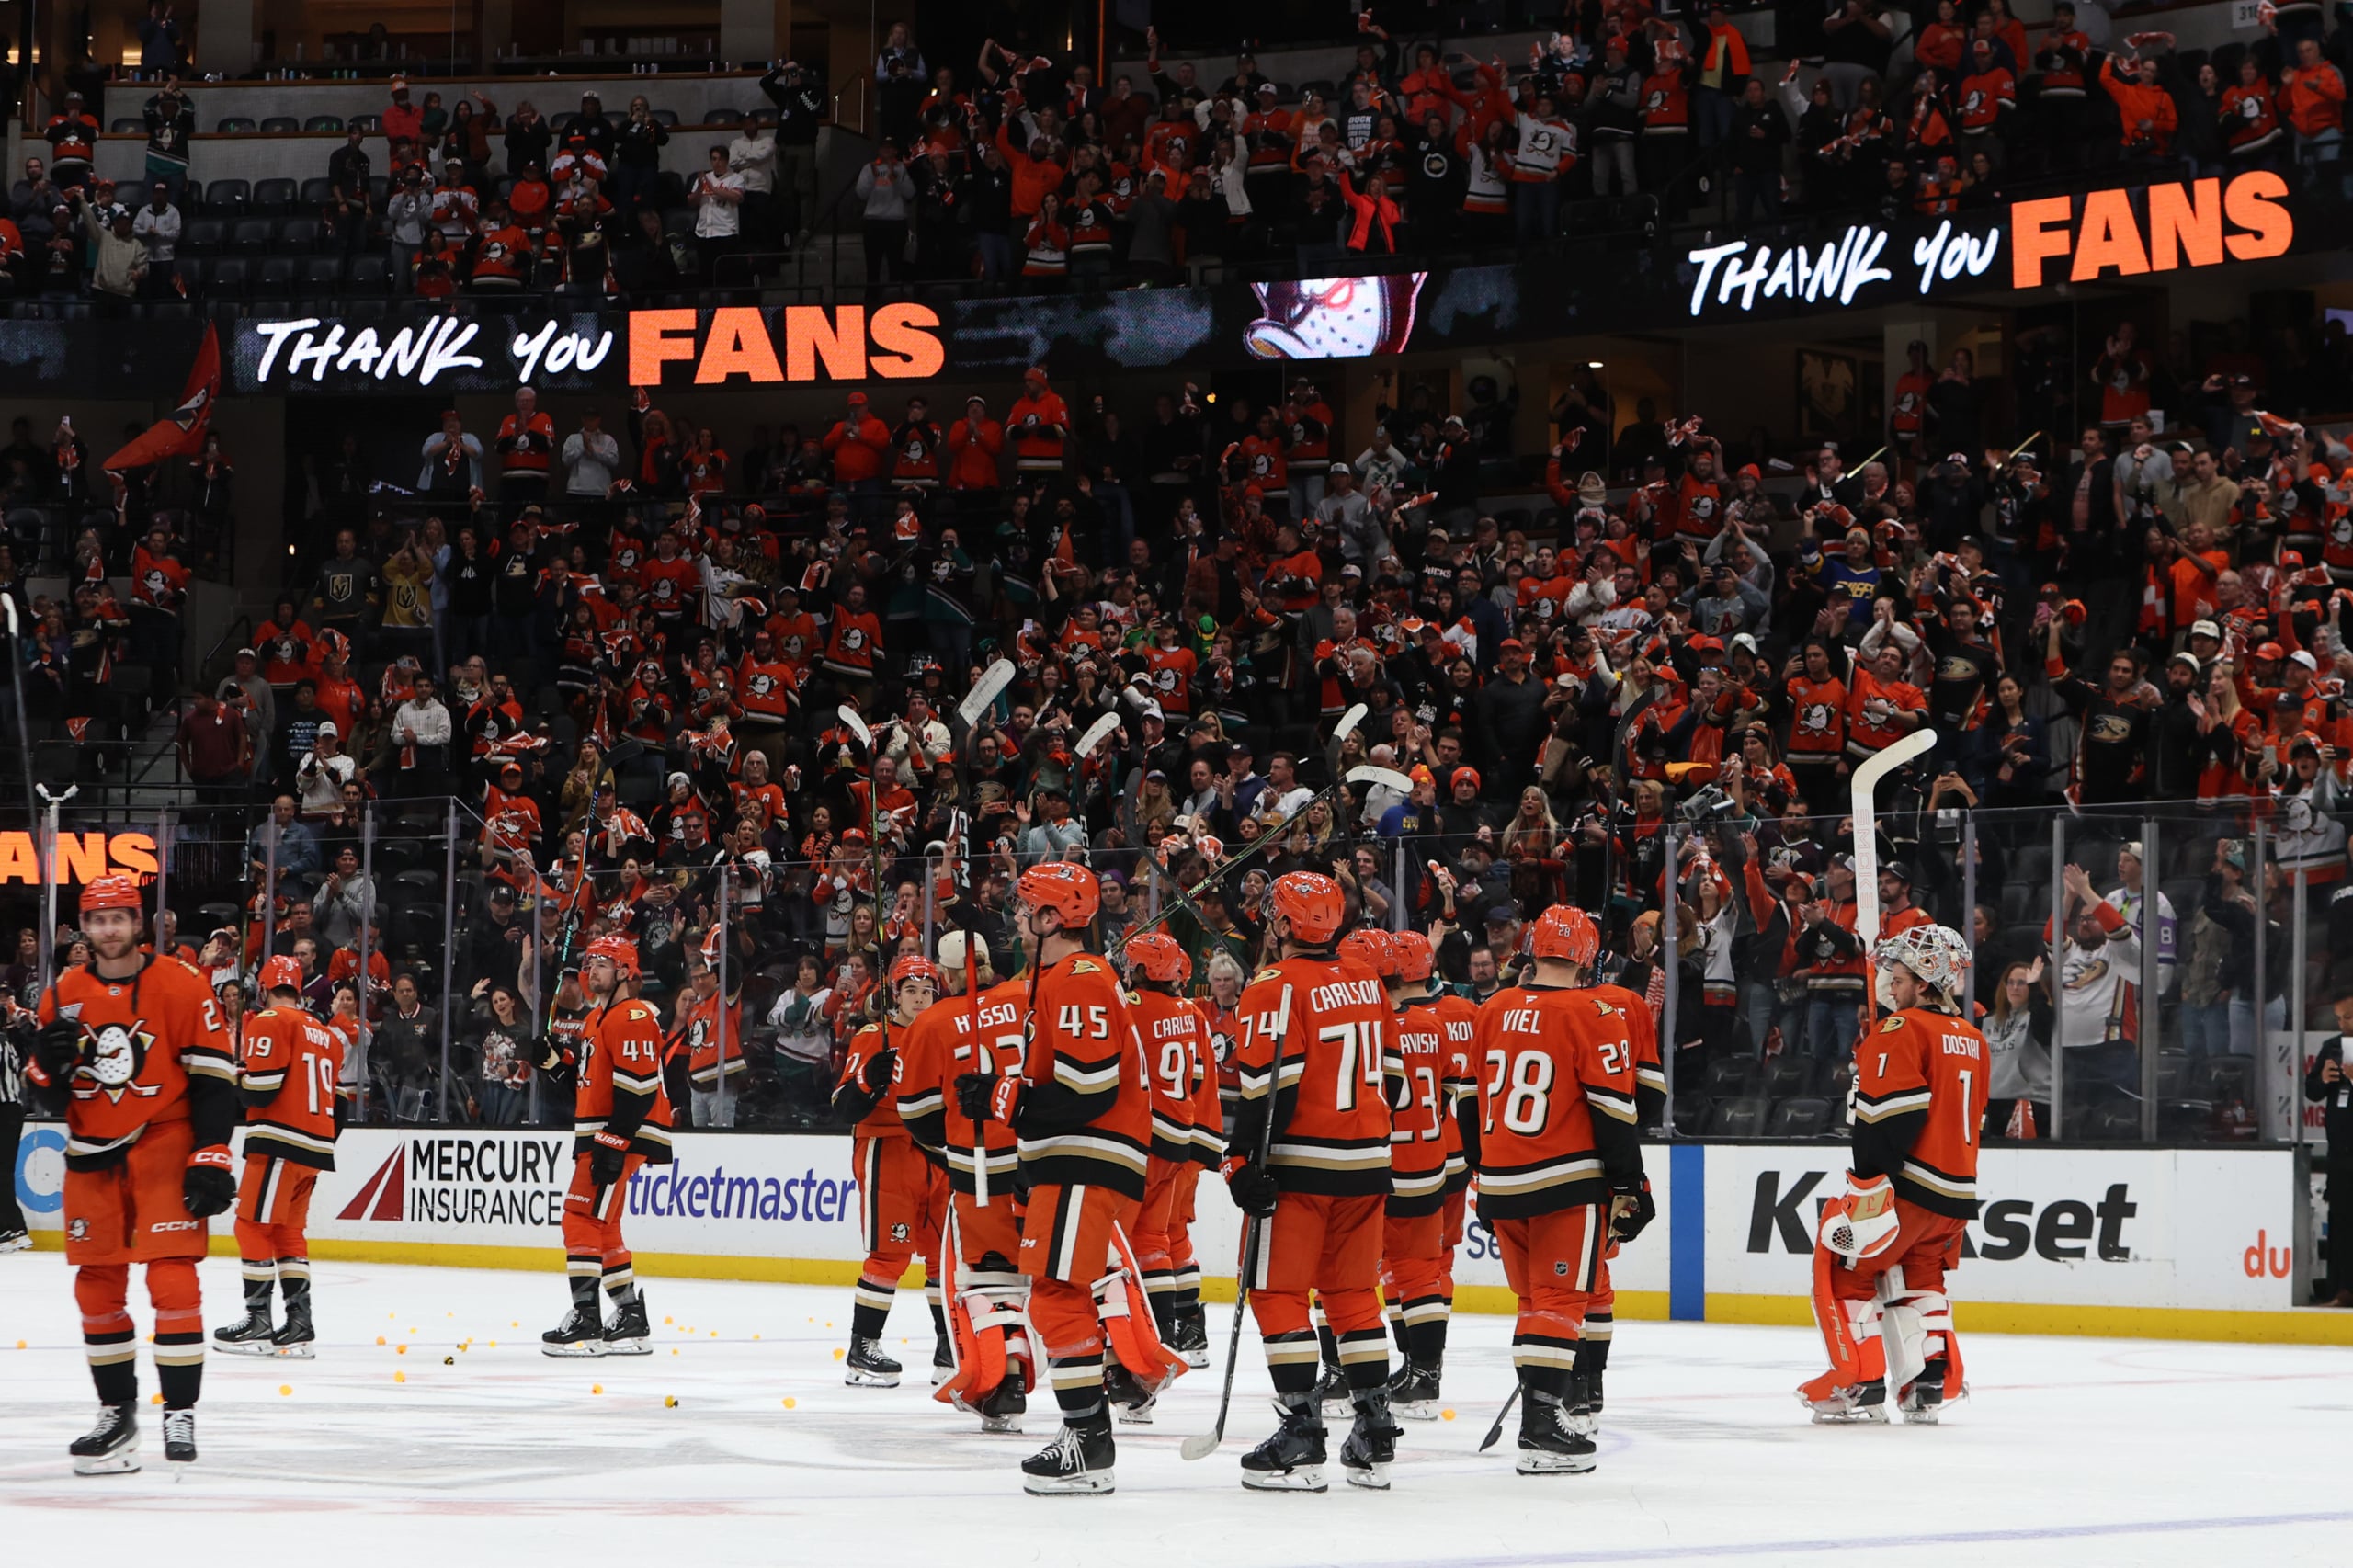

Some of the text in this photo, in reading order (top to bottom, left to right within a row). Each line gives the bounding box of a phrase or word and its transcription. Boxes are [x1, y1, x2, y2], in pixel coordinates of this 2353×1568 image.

[1688, 225, 1892, 316] THANK
[2011, 169, 2294, 290] FANS
[256, 314, 483, 386] THANK
[628, 302, 945, 386] FANS
[957, 809, 971, 888] CCM
[1079, 814, 1092, 868] CCM
[1558, 926, 1571, 937] 28
[2161, 926, 2173, 944] 8
[1058, 1005, 1109, 1040] 45
[1240, 1010, 1279, 1049] 74
[1502, 1008, 1540, 1035] VIEL
[247, 1036, 273, 1058] 19
[622, 1040, 656, 1062] 44
[1319, 1021, 1386, 1111] 74
[1598, 1040, 1631, 1074] 28
[1877, 1053, 1889, 1078] 1
[301, 1052, 334, 1118] 19
[1484, 1049, 1554, 1135] 28
[1958, 1069, 1972, 1147] 1
[412, 1139, 563, 1184] MERCURY
[411, 1188, 562, 1225] INSURANCE
[629, 1158, 856, 1222] ticketmaster
[151, 1221, 199, 1233] CCM
[1746, 1170, 2138, 1263] Kset
[2243, 1229, 2290, 1278] du
[950, 1300, 965, 1361] TRUE
[1828, 1299, 1850, 1362] TRUE
